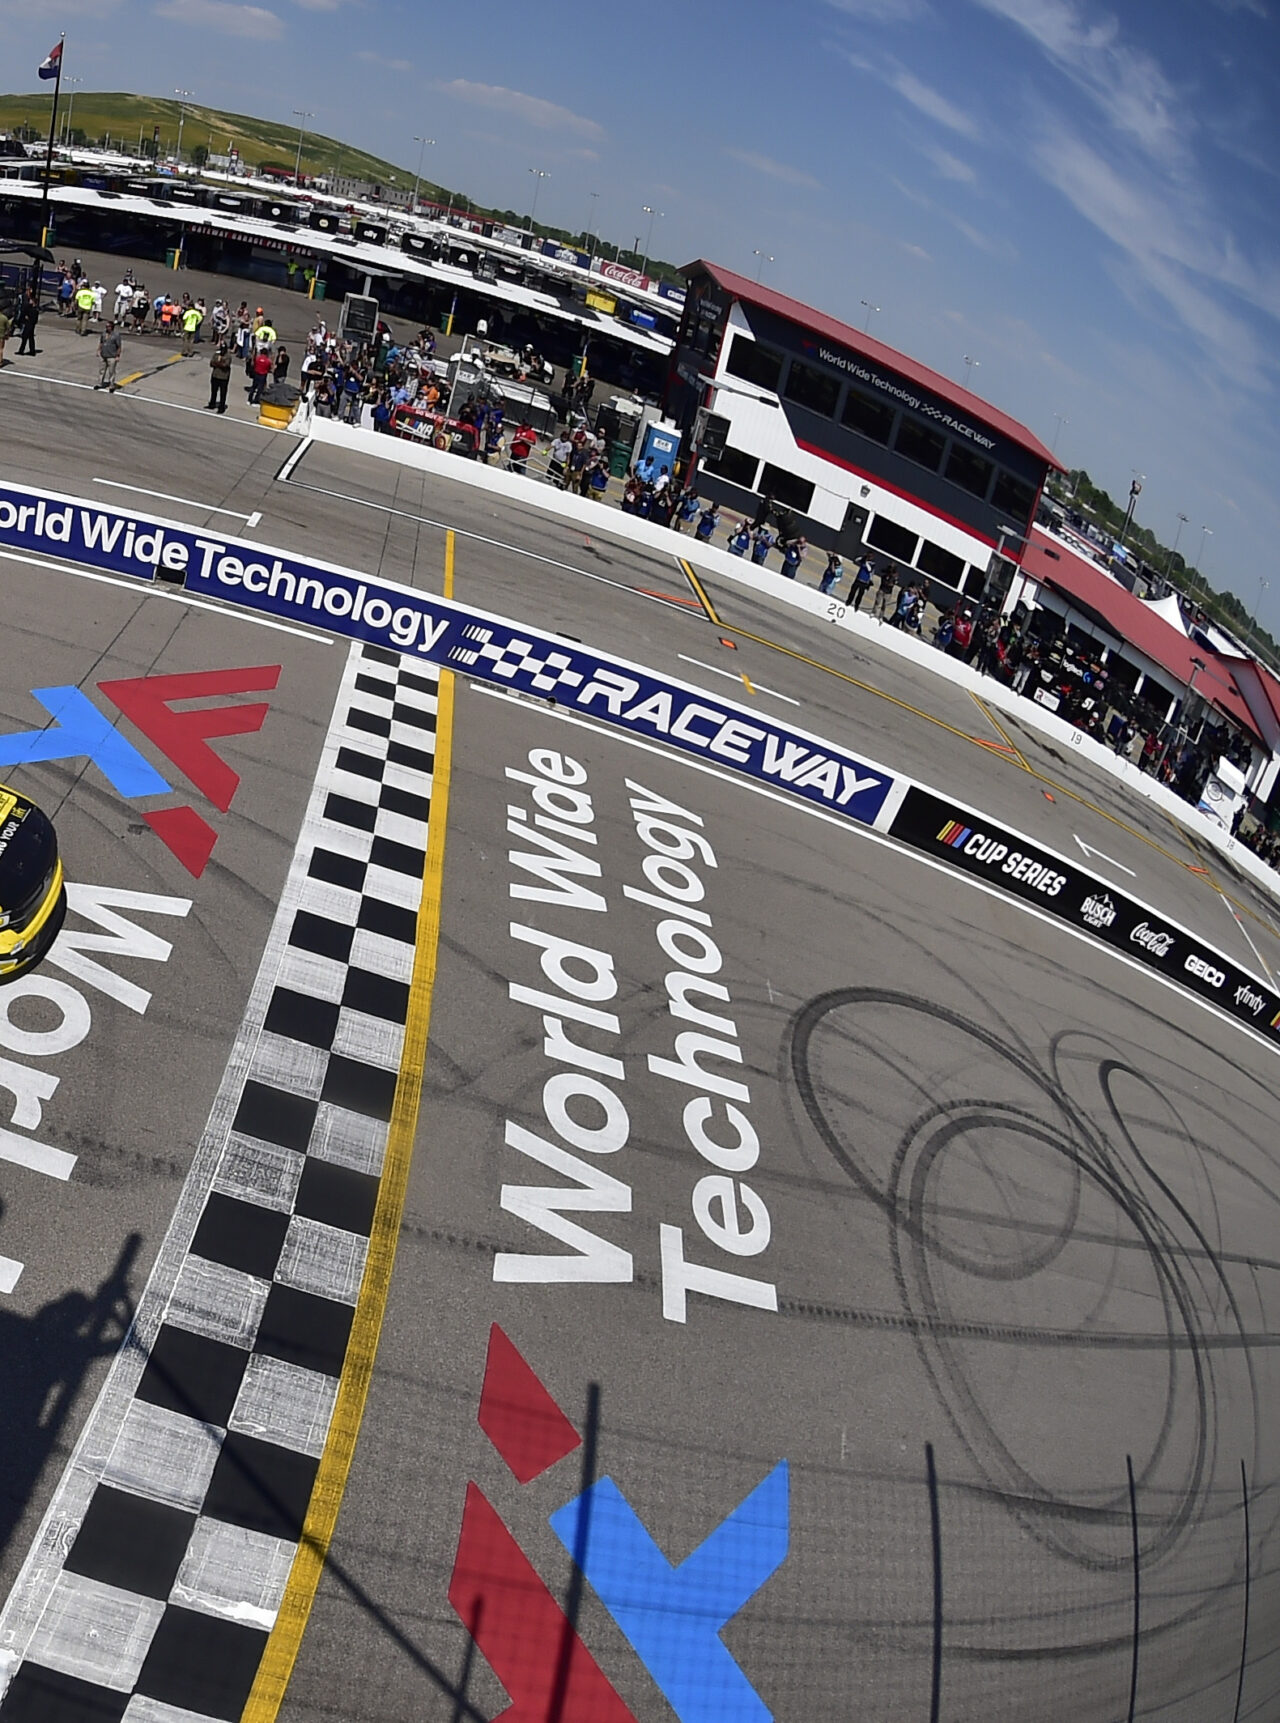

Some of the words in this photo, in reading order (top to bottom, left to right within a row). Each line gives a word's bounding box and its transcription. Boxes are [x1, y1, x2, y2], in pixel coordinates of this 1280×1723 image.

[819, 348, 847, 369] World
[847, 361, 870, 381] Wide
[869, 372, 921, 409] Technology
[941, 414, 997, 450] RACEWAY
[80, 510, 188, 570] Wide
[194, 539, 450, 653] Technology
[827, 603, 846, 619] 20
[1081, 697, 1095, 711] 51
[576, 668, 883, 806] RACEWAY
[1071, 731, 1083, 745] 19
[0, 821, 20, 841] YOUR
[504, 747, 608, 912] Wide
[963, 833, 1005, 866] CUP
[1001, 852, 1067, 897] SERIES
[1080, 897, 1117, 927] BUSCH
[1184, 953, 1226, 988] GEICO
[1233, 985, 1267, 1016] xfinity
[623, 777, 779, 1324] Technology
[492, 921, 634, 1284] World
